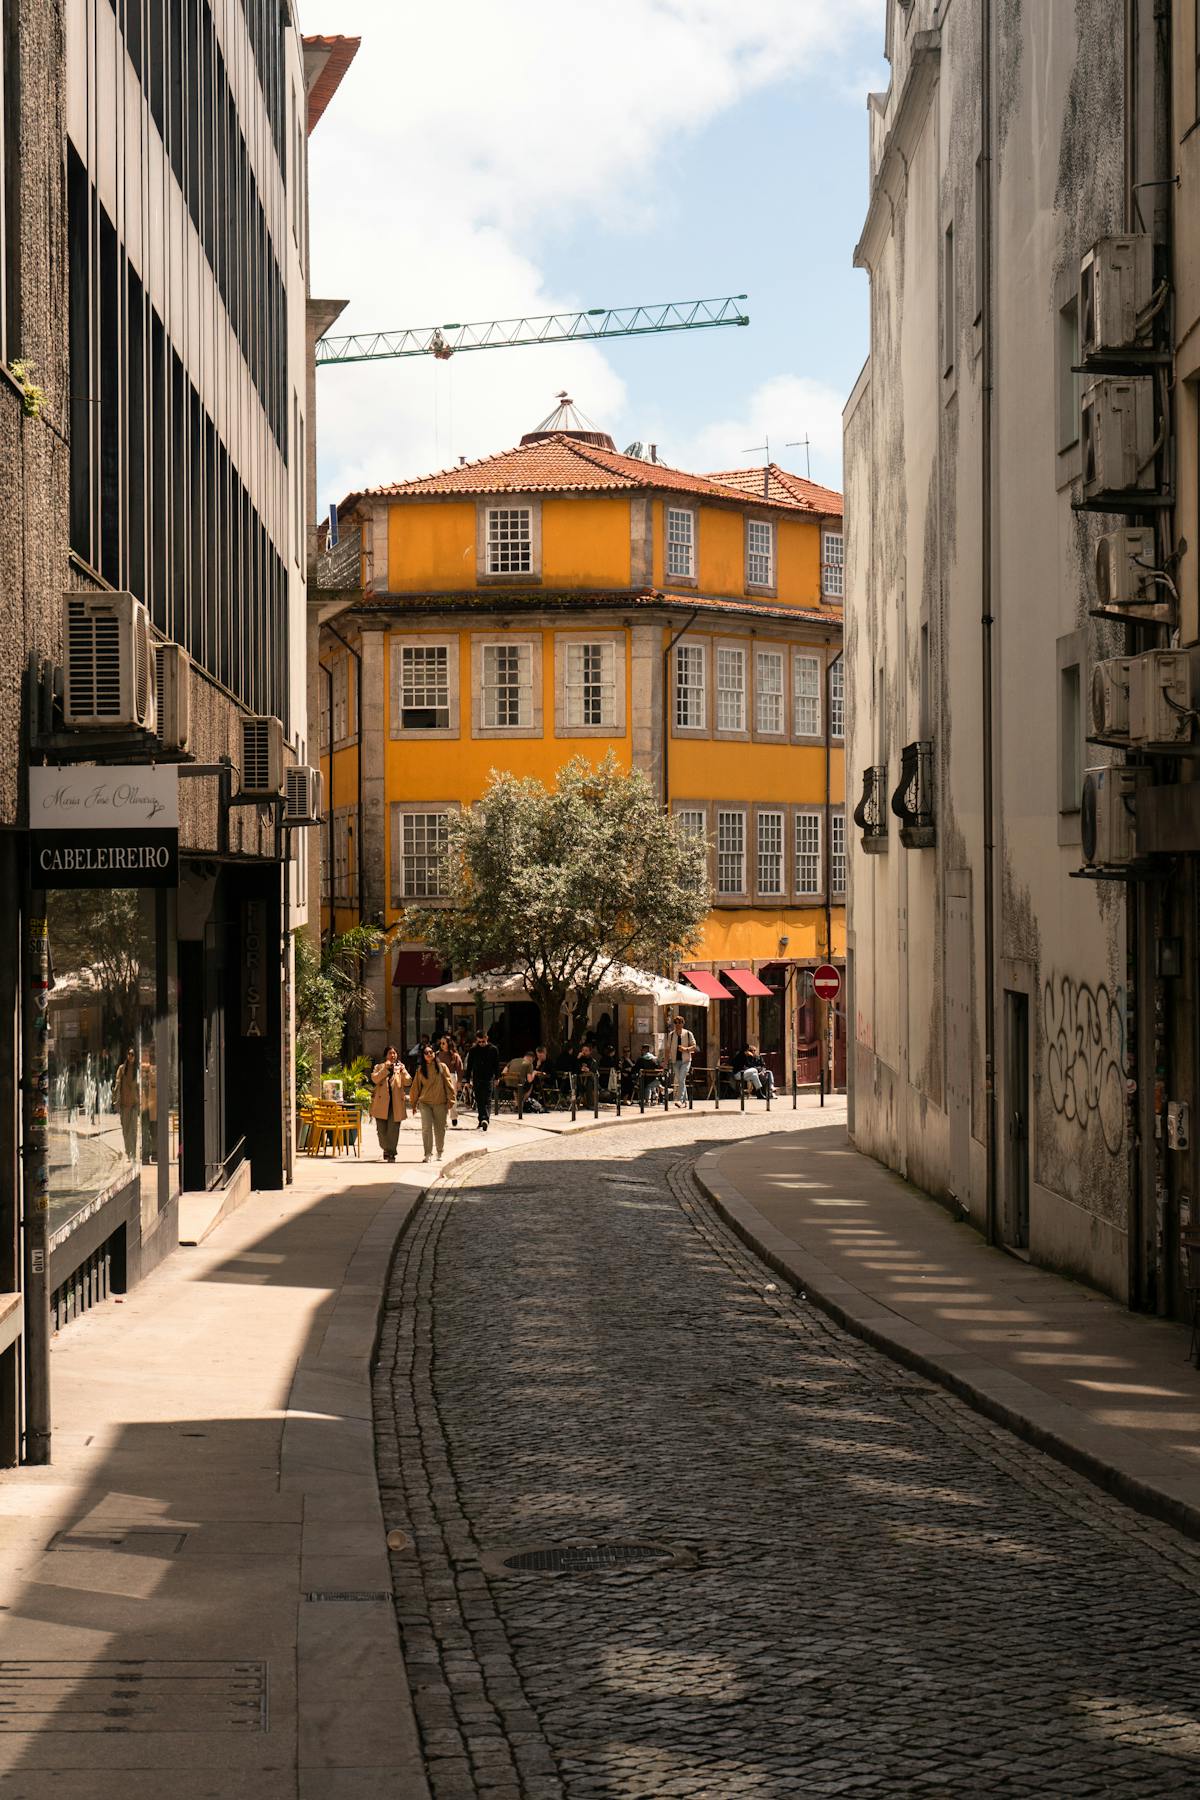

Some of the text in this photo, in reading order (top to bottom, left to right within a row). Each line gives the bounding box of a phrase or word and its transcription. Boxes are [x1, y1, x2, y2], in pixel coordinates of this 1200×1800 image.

[42, 785, 81, 810] Maria
[39, 846, 170, 871] CABELEIREIRO
[246, 900, 262, 1037] FLORISTA
